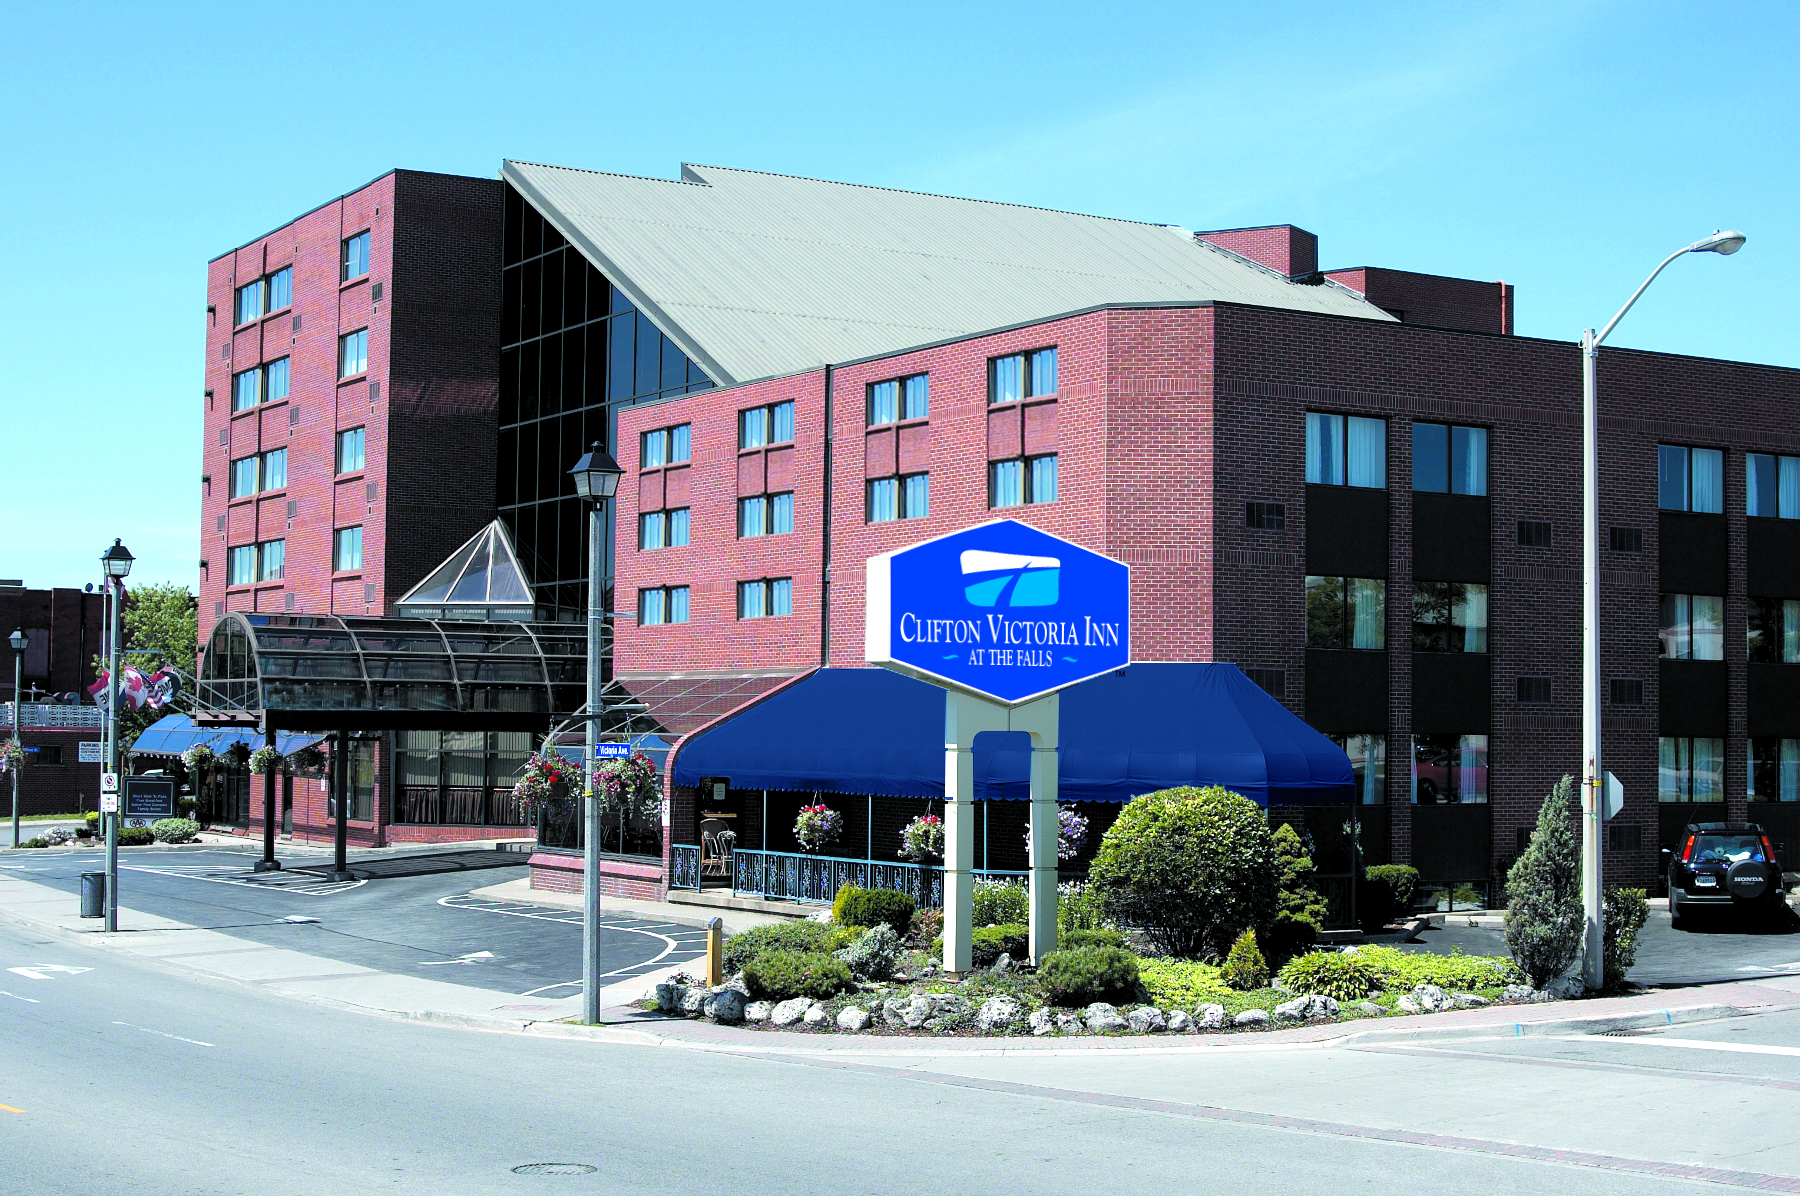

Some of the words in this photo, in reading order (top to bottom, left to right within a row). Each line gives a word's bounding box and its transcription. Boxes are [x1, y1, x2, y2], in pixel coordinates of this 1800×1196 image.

[900, 612, 981, 643] CLIFTON
[986, 614, 1079, 646] VICTORIA
[1084, 615, 1119, 647] INN
[968, 649, 985, 665] AT
[988, 649, 1014, 666] THE
[1017, 649, 1053, 667] FALLS
[1115, 670, 1126, 678] TM
[600, 745, 617, 755] Victoria
